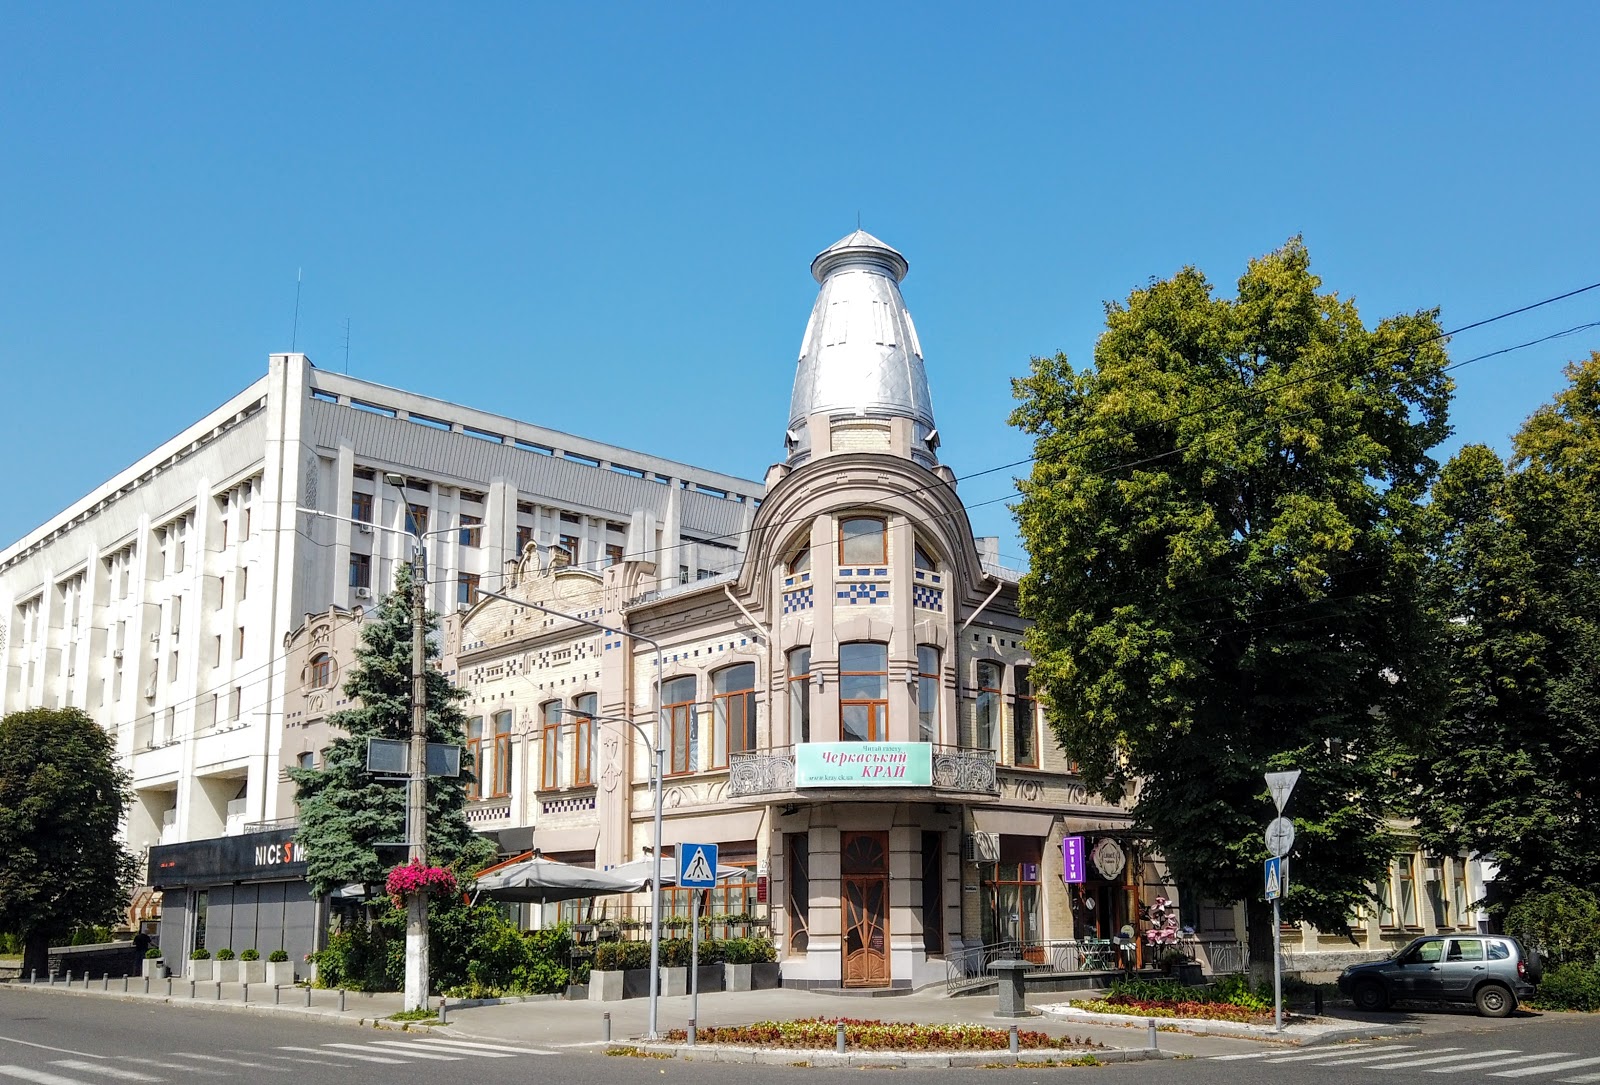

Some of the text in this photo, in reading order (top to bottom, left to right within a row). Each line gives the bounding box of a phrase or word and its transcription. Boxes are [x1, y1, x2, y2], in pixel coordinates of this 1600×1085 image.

[822, 751, 907, 766] Черкаський
[861, 764, 907, 778] КРАЙ
[255, 844, 281, 866] NICE
